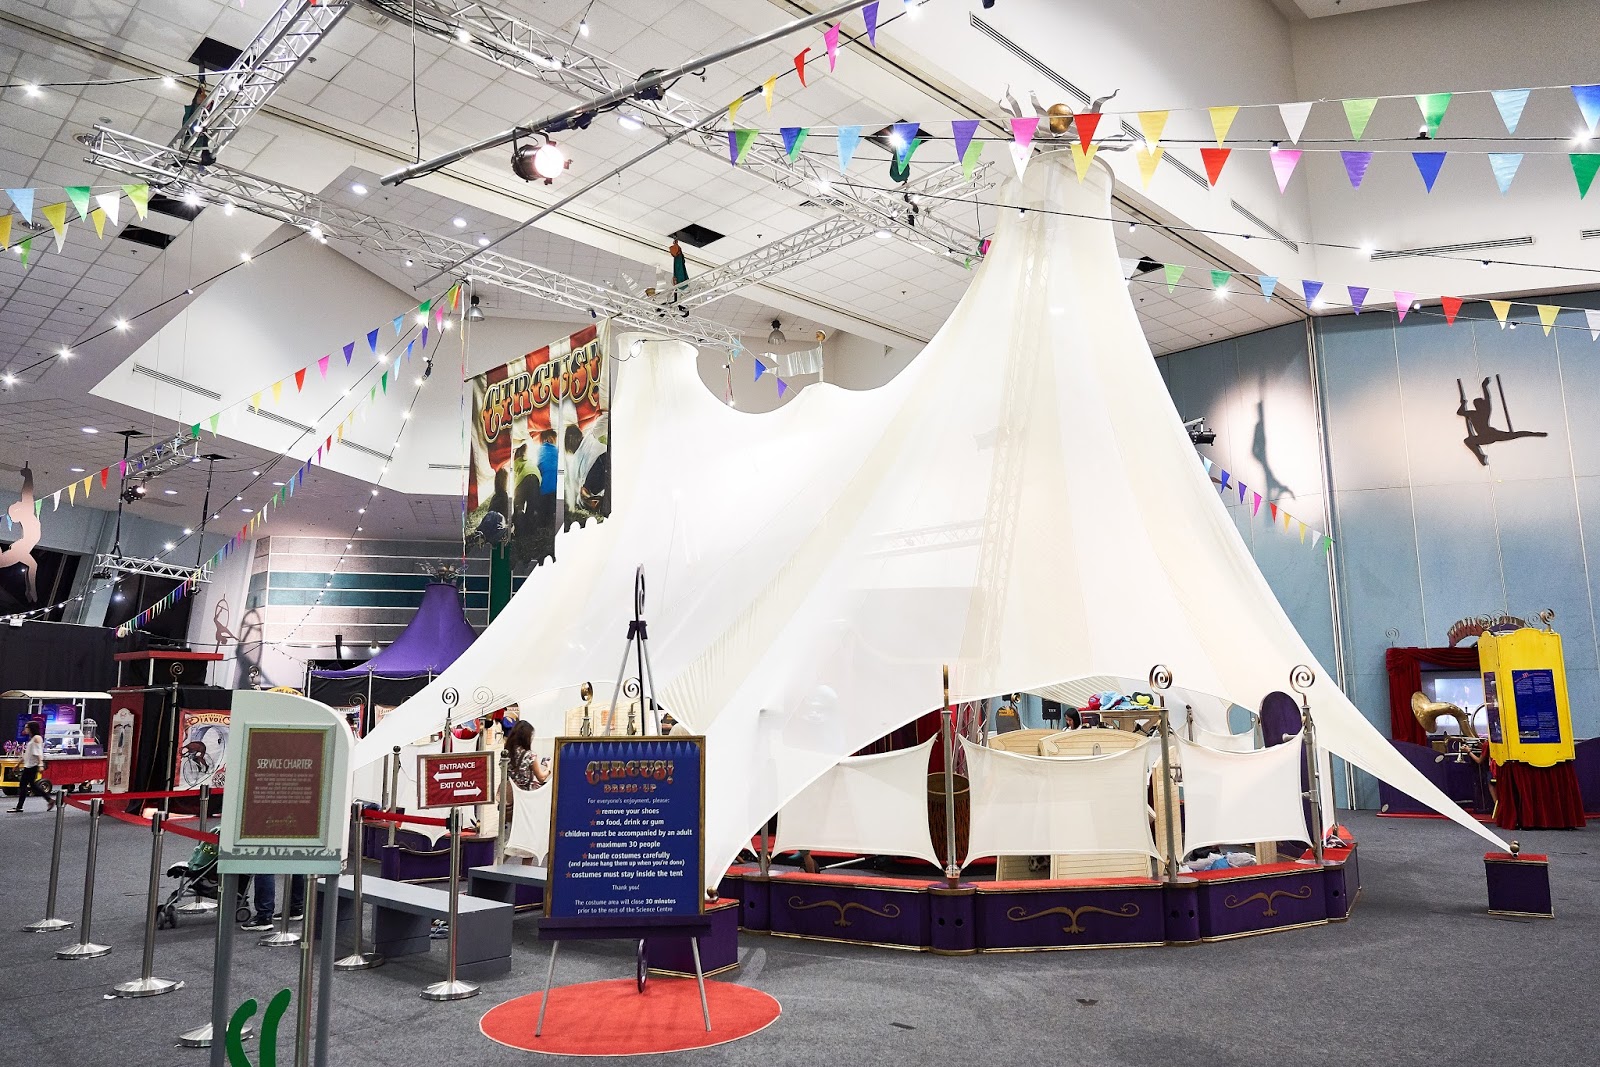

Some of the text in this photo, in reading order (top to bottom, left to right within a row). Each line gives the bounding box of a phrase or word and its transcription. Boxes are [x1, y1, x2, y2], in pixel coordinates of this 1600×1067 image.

[481, 340, 600, 443] CIRCUS!
[257, 758, 313, 770] SERVICE CHARTER
[439, 762, 476, 770] ENTRANCE
[584, 760, 674, 784] CIRCUS!
